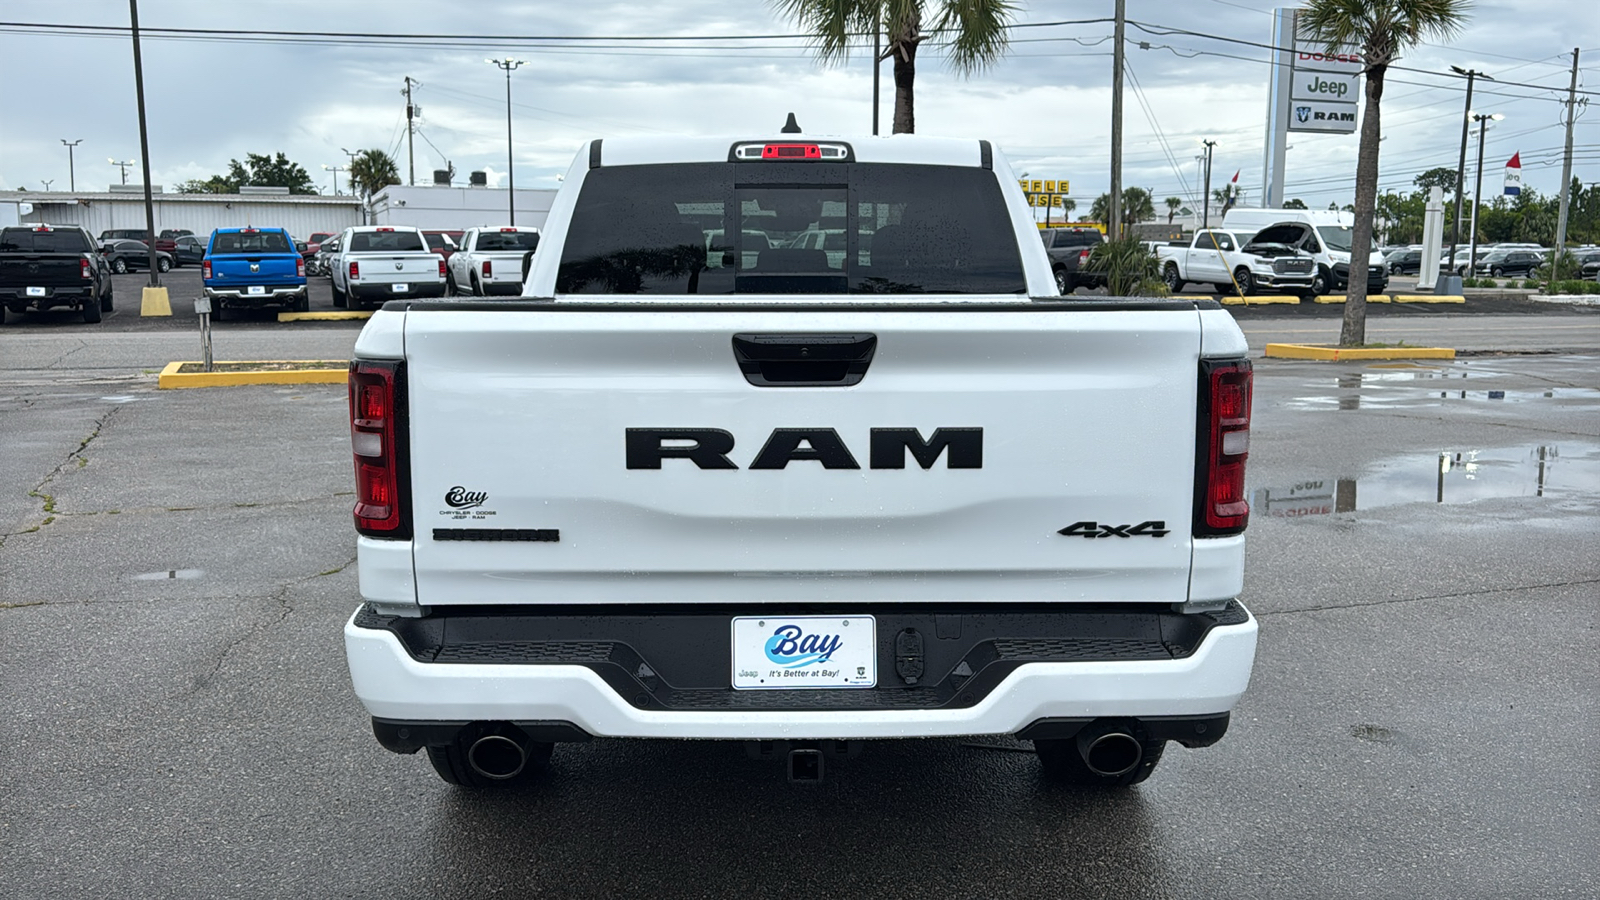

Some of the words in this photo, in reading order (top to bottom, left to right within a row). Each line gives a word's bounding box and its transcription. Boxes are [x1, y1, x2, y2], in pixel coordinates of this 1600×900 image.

[1307, 76, 1348, 98] Jeep
[1314, 111, 1355, 122] RAM
[625, 426, 984, 471] RAM
[445, 485, 489, 508] Bay
[1056, 520, 1172, 538] 4x4
[769, 624, 843, 664] Bay
[768, 669, 782, 678] It's
[783, 669, 810, 678] Better
[821, 669, 840, 679] Bay!
